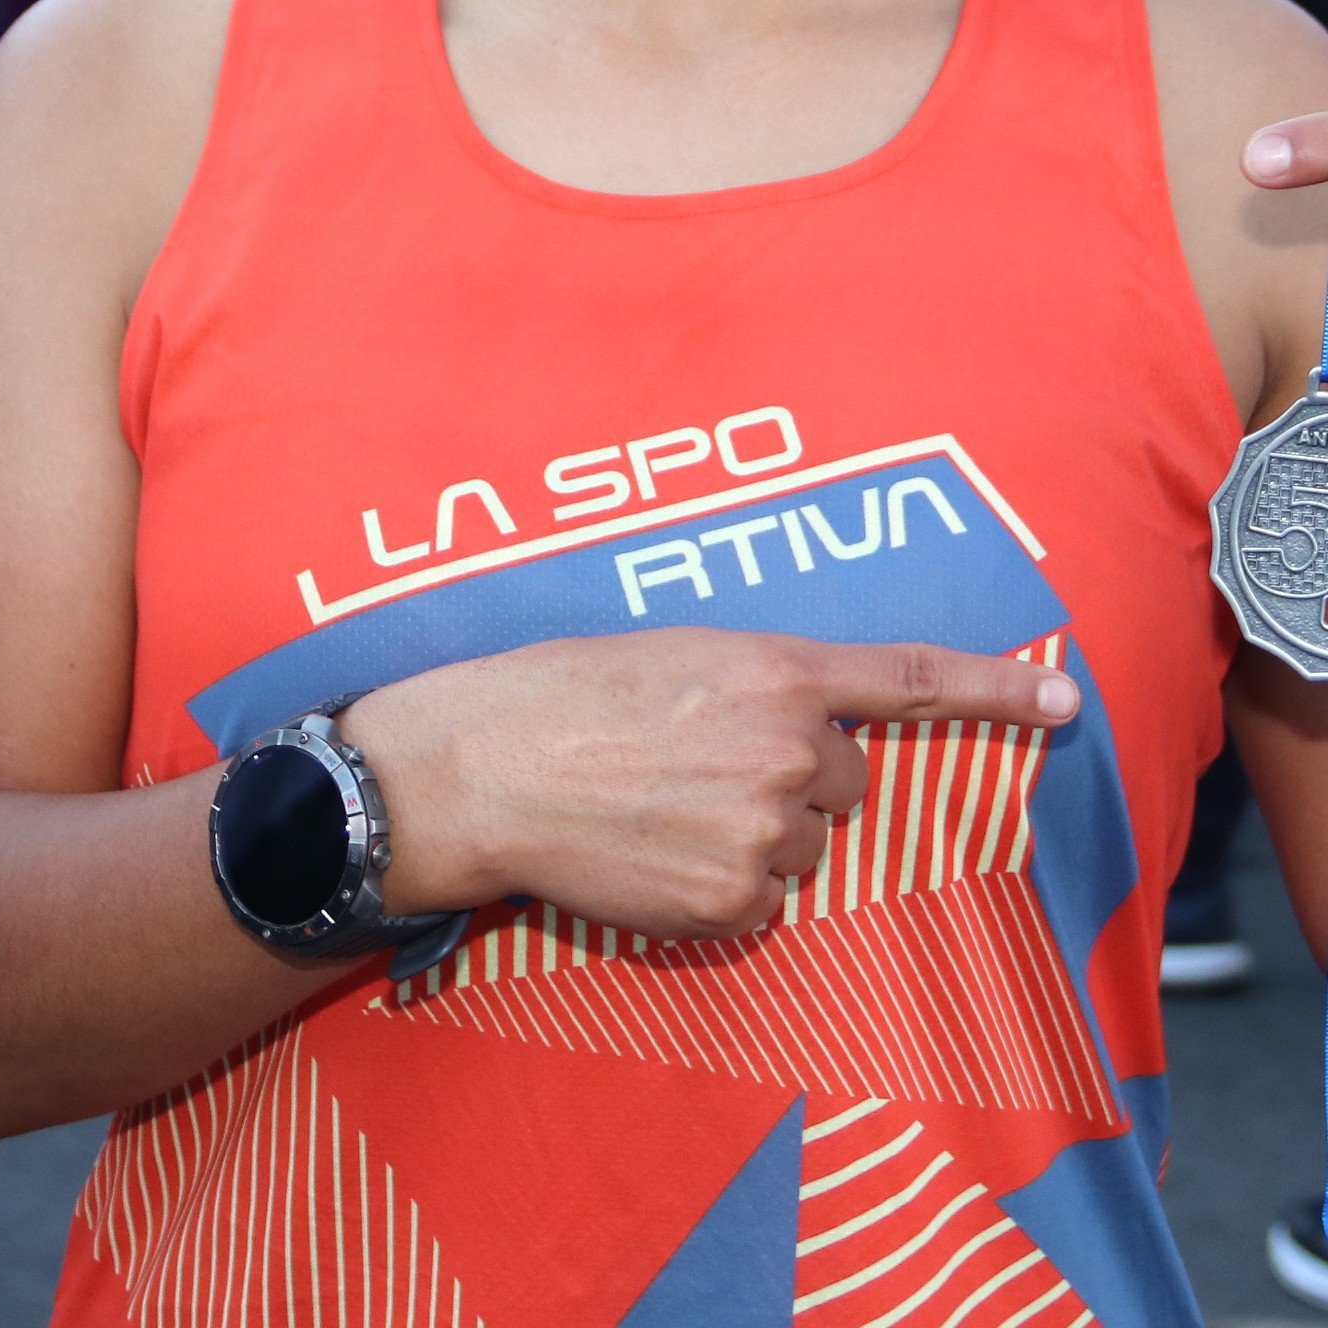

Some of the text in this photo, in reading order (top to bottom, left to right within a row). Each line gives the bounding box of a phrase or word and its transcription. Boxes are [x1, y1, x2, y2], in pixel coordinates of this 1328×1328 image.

[361, 404, 804, 568] LA SPO
[614, 475, 968, 618] RTIVA
